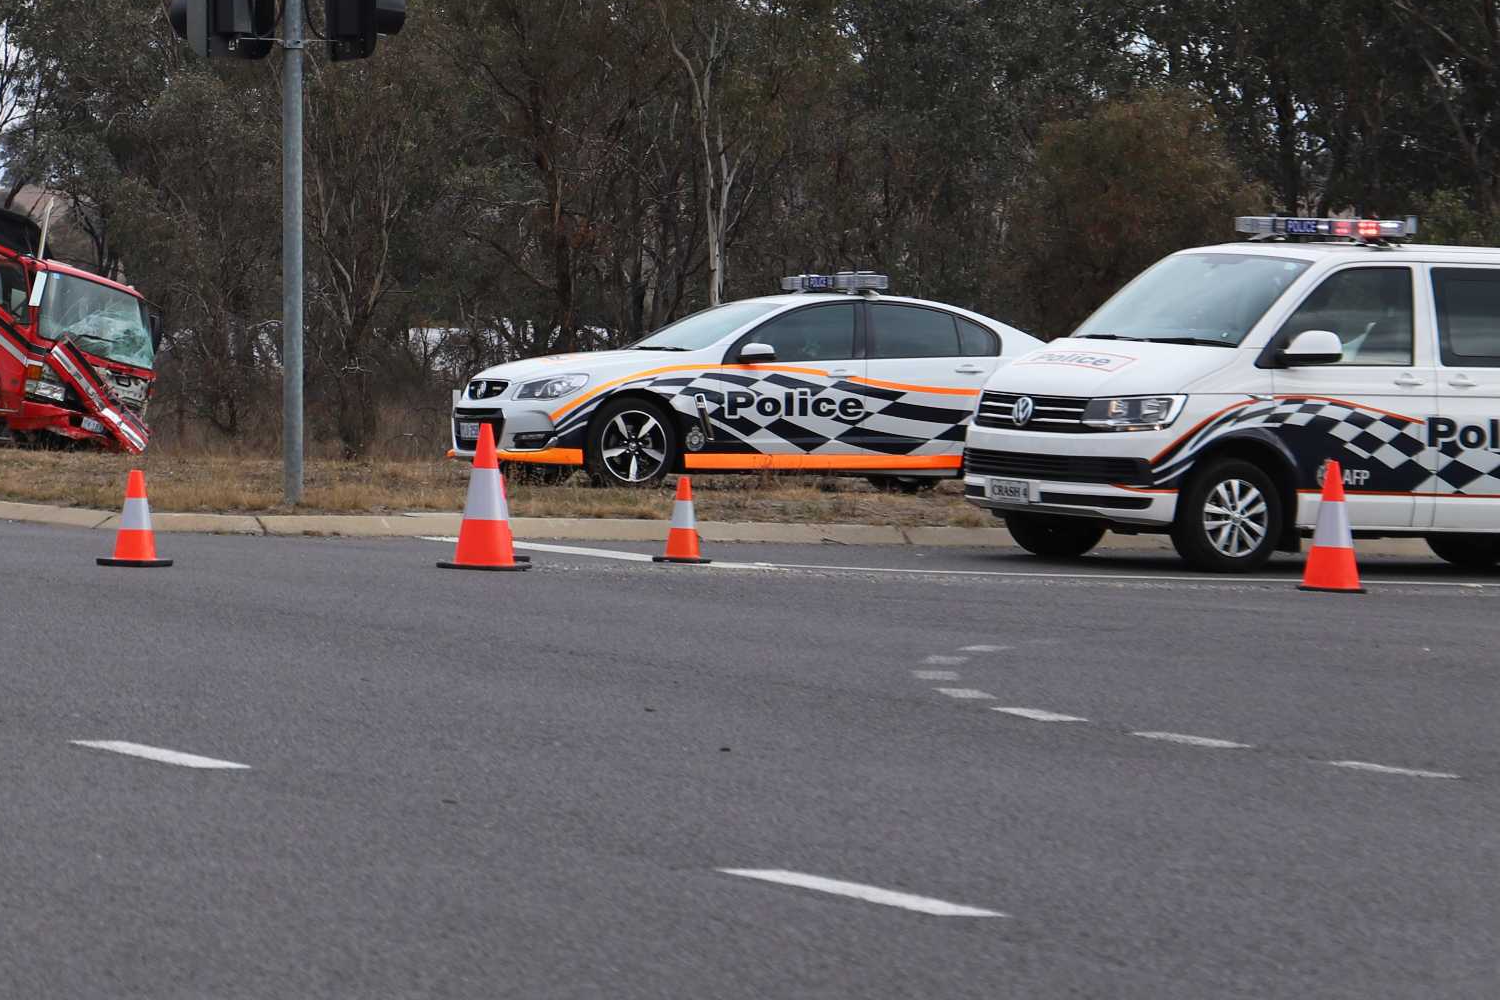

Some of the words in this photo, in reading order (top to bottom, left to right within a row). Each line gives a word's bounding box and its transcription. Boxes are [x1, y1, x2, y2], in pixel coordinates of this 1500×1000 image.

[1287, 220, 1317, 232] POLICE
[810, 276, 827, 288] POLICE
[1031, 353, 1111, 366] Police
[726, 389, 865, 419] Police
[1343, 469, 1370, 486] AFP
[991, 484, 1020, 498] CRASH
